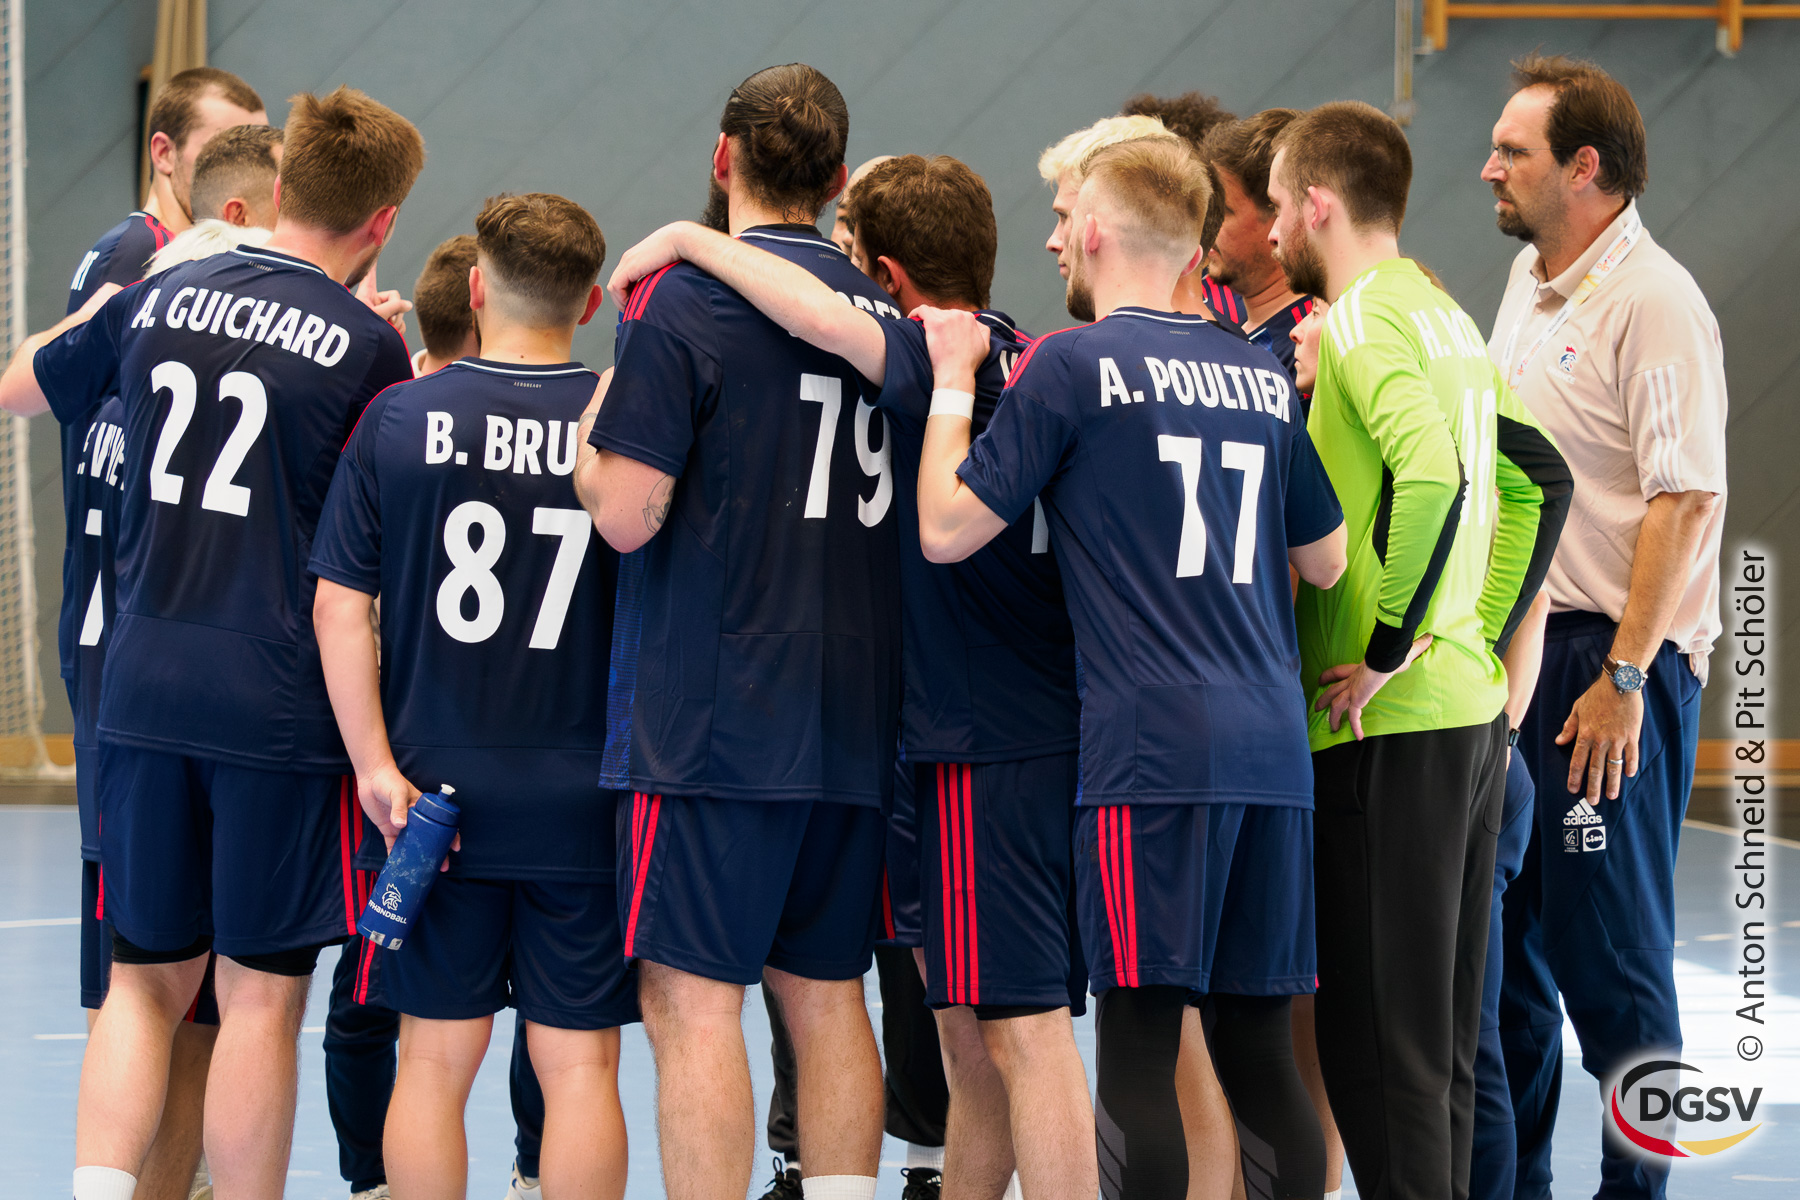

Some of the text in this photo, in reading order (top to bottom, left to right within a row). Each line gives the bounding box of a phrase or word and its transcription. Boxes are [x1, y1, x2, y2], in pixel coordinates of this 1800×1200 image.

[131, 286, 350, 367] A. GUICHARD
[150, 360, 268, 517] 22
[426, 411, 468, 465] B.
[1099, 356, 1290, 423] A. POULTIER
[800, 372, 893, 528] 79
[1157, 434, 1265, 585] 77
[436, 500, 593, 650] 87
[1563, 814, 1603, 826] adidas
